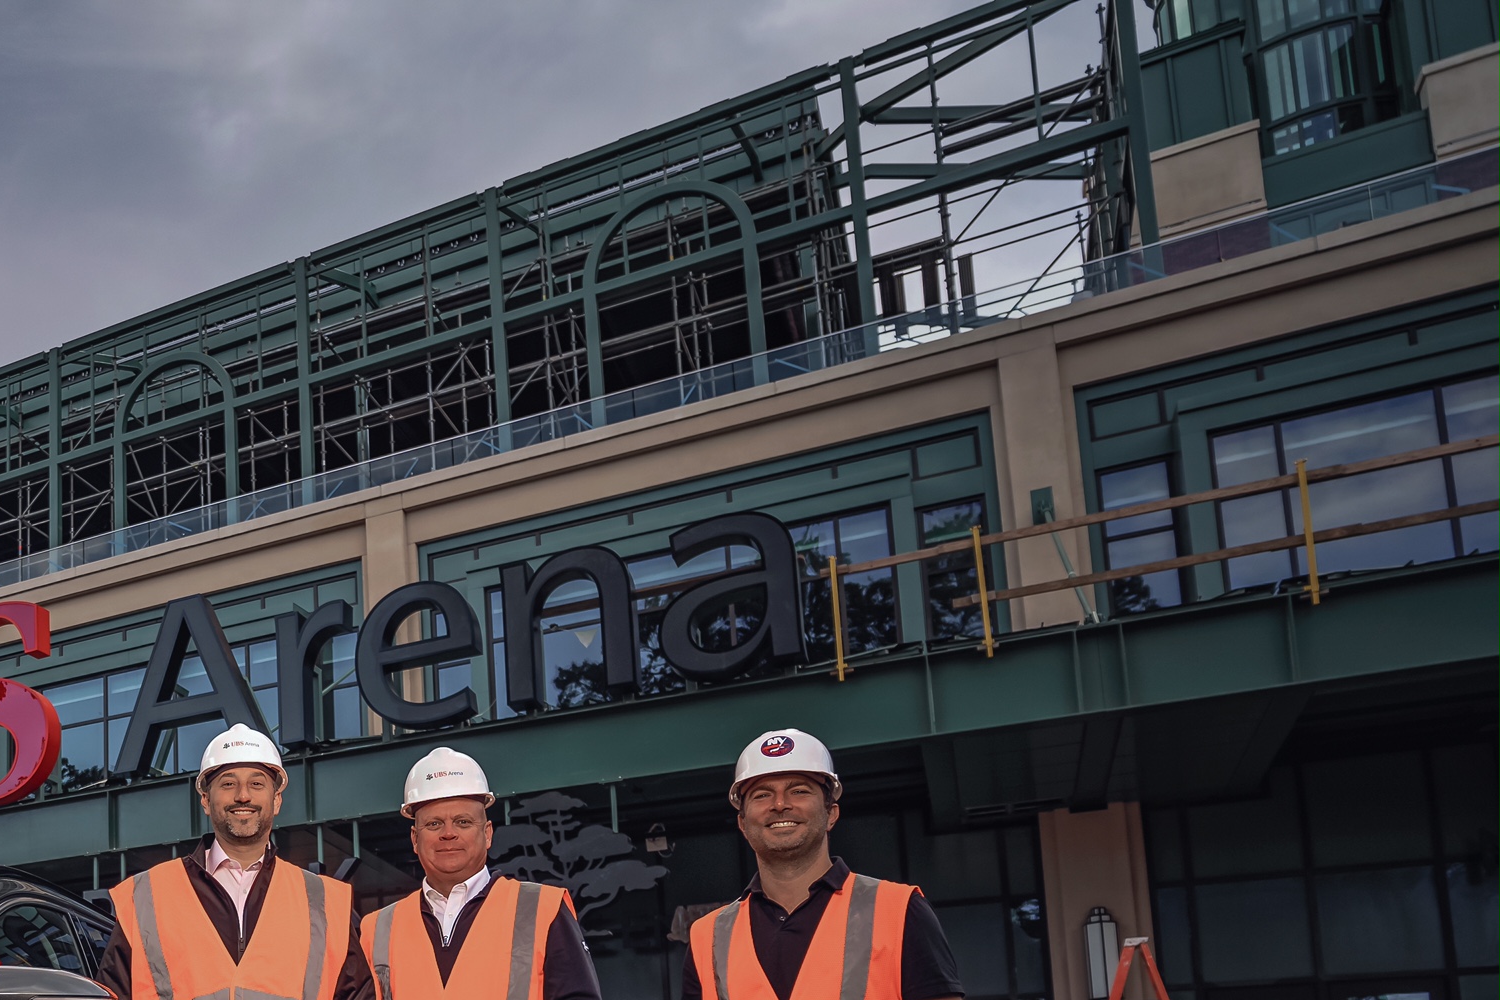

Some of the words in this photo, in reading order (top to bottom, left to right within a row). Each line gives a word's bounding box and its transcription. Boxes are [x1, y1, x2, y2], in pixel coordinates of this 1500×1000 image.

[113, 511, 808, 777] Arena
[767, 737, 787, 748] NY
[433, 771, 448, 779] UBS
